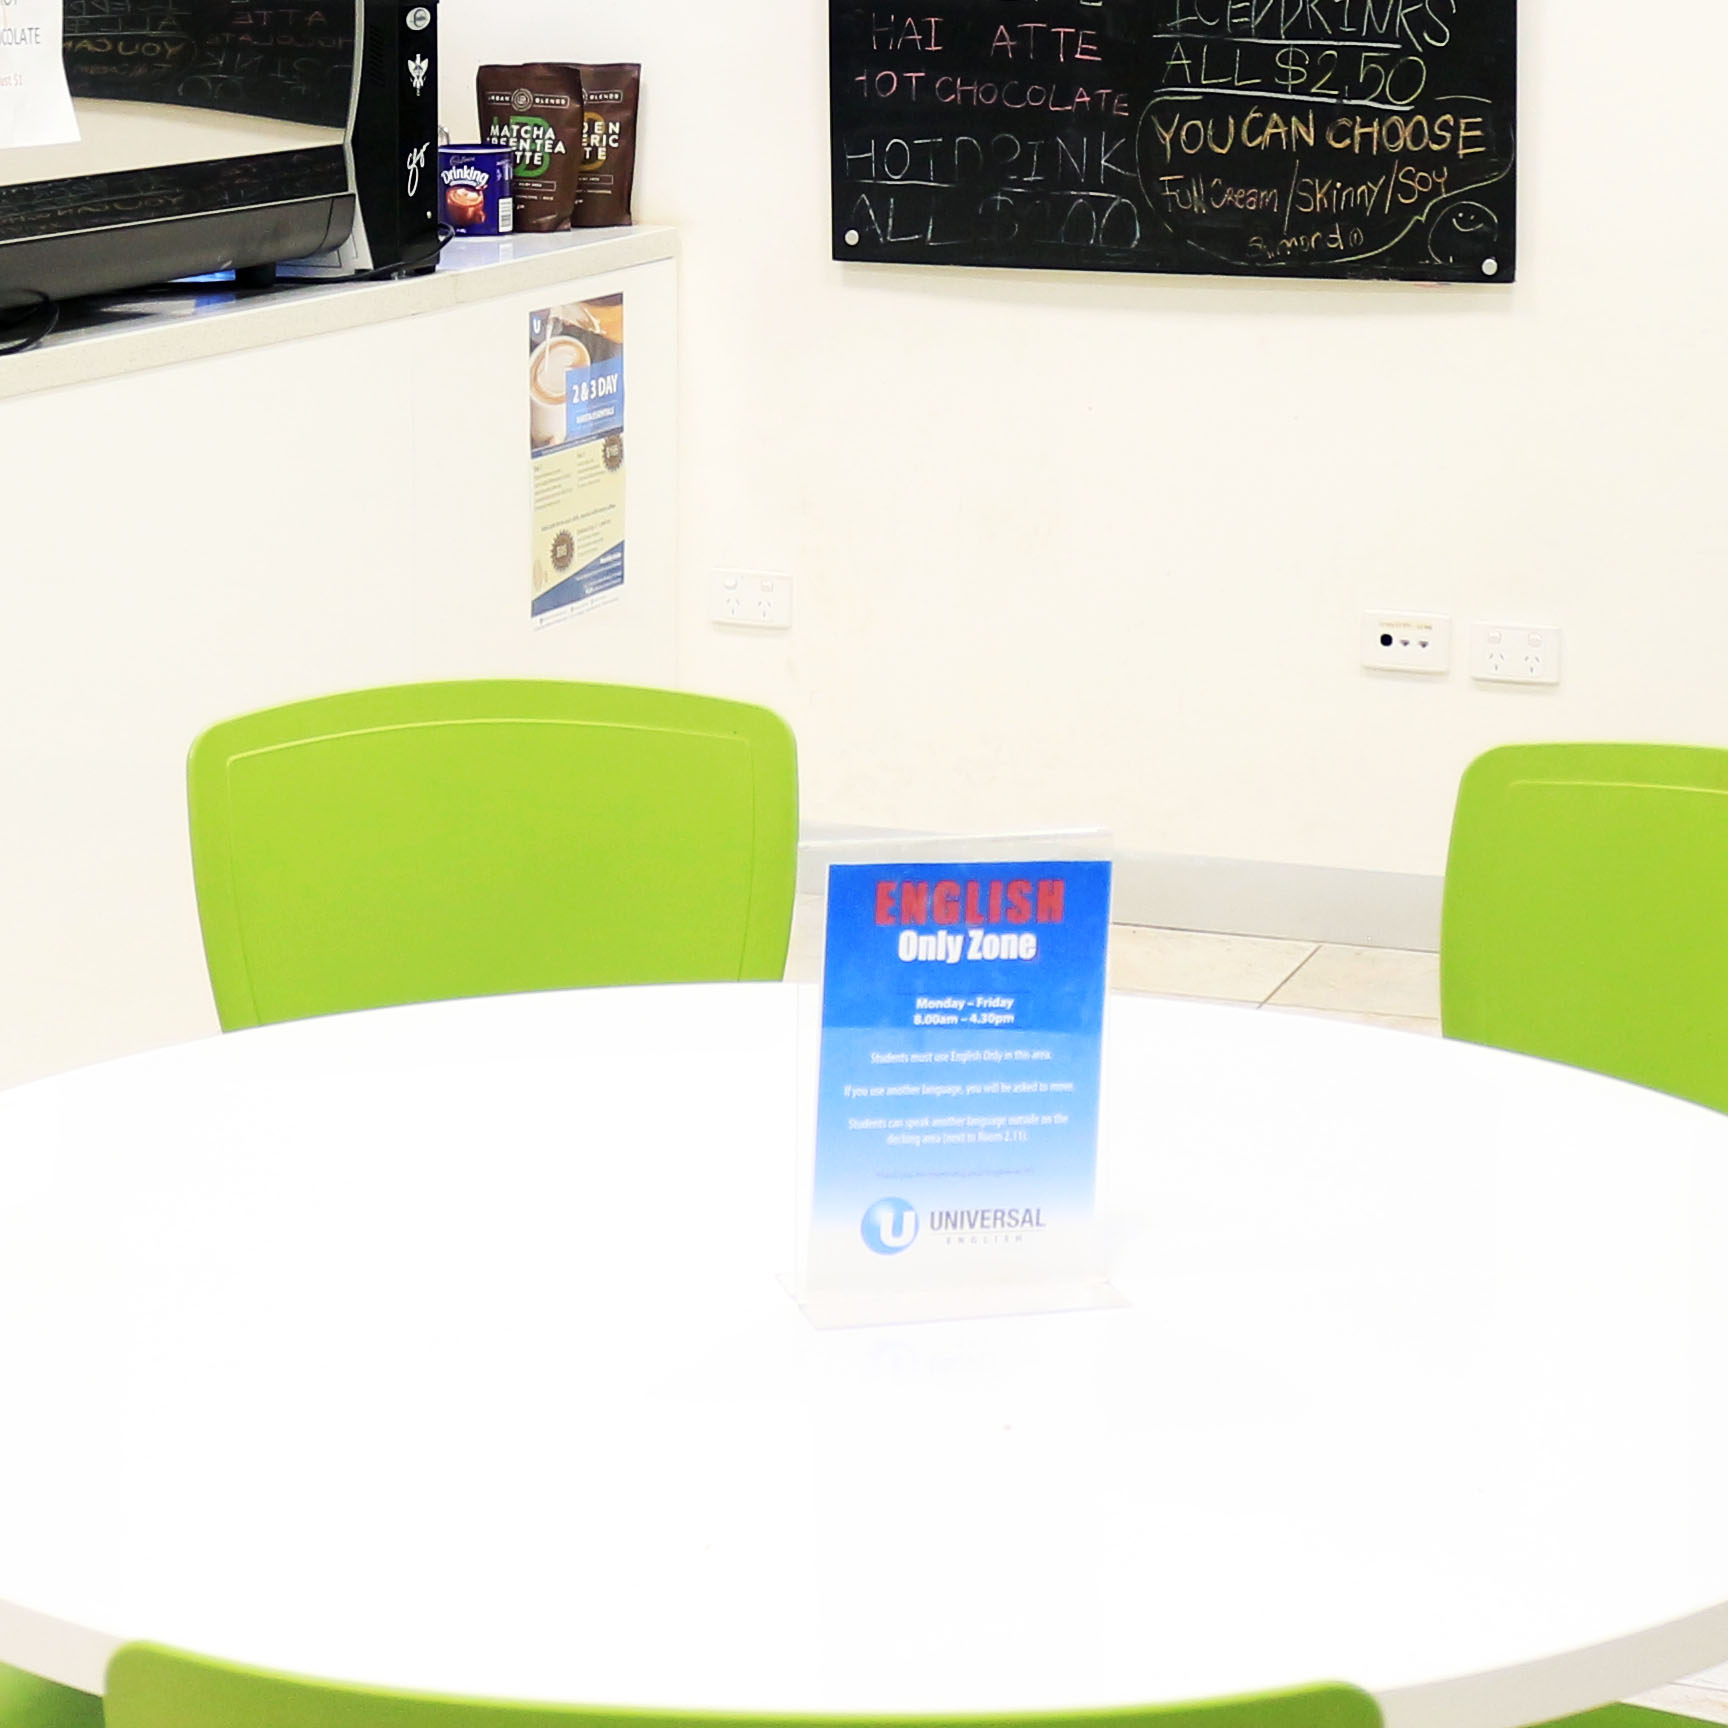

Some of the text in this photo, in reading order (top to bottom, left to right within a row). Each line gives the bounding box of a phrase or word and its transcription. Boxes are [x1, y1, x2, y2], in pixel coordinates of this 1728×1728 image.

[1162, 41, 1427, 105] ALL $2.50
[934, 75, 1130, 117] CHOCOLATE
[489, 124, 556, 140] MATCHA
[1151, 105, 1486, 164] YOU CAN CHOOSE
[534, 139, 566, 154] TEA
[440, 164, 490, 188] Drinking
[572, 384, 579, 404] 2
[590, 379, 598, 400] 3
[598, 373, 619, 397] DAY
[874, 879, 1066, 926] ENGLISH
[897, 928, 1039, 963] Only Zone
[915, 996, 1014, 1012] Monday Friday
[969, 1013, 1015, 1027] 4.30pm
[870, 1051, 909, 1064] Students
[911, 1052, 933, 1063] must
[950, 1050, 982, 1064] English
[983, 1049, 1003, 1063] Only
[851, 1086, 869, 1098] you
[870, 1086, 885, 1096] use
[886, 1084, 920, 1096] another
[965, 1085, 982, 1097] you
[1013, 1081, 1038, 1093] asked
[848, 1117, 886, 1130] Students
[887, 1119, 904, 1129] can
[905, 1118, 930, 1130] speak
[931, 1116, 965, 1128] another
[966, 1115, 1007, 1129] language
[1007, 1114, 1039, 1126] outside
[1054, 1113, 1069, 1124] the
[929, 1207, 1046, 1232] UNIVERSAL
[946, 1234, 1023, 1245] ENGLISH
